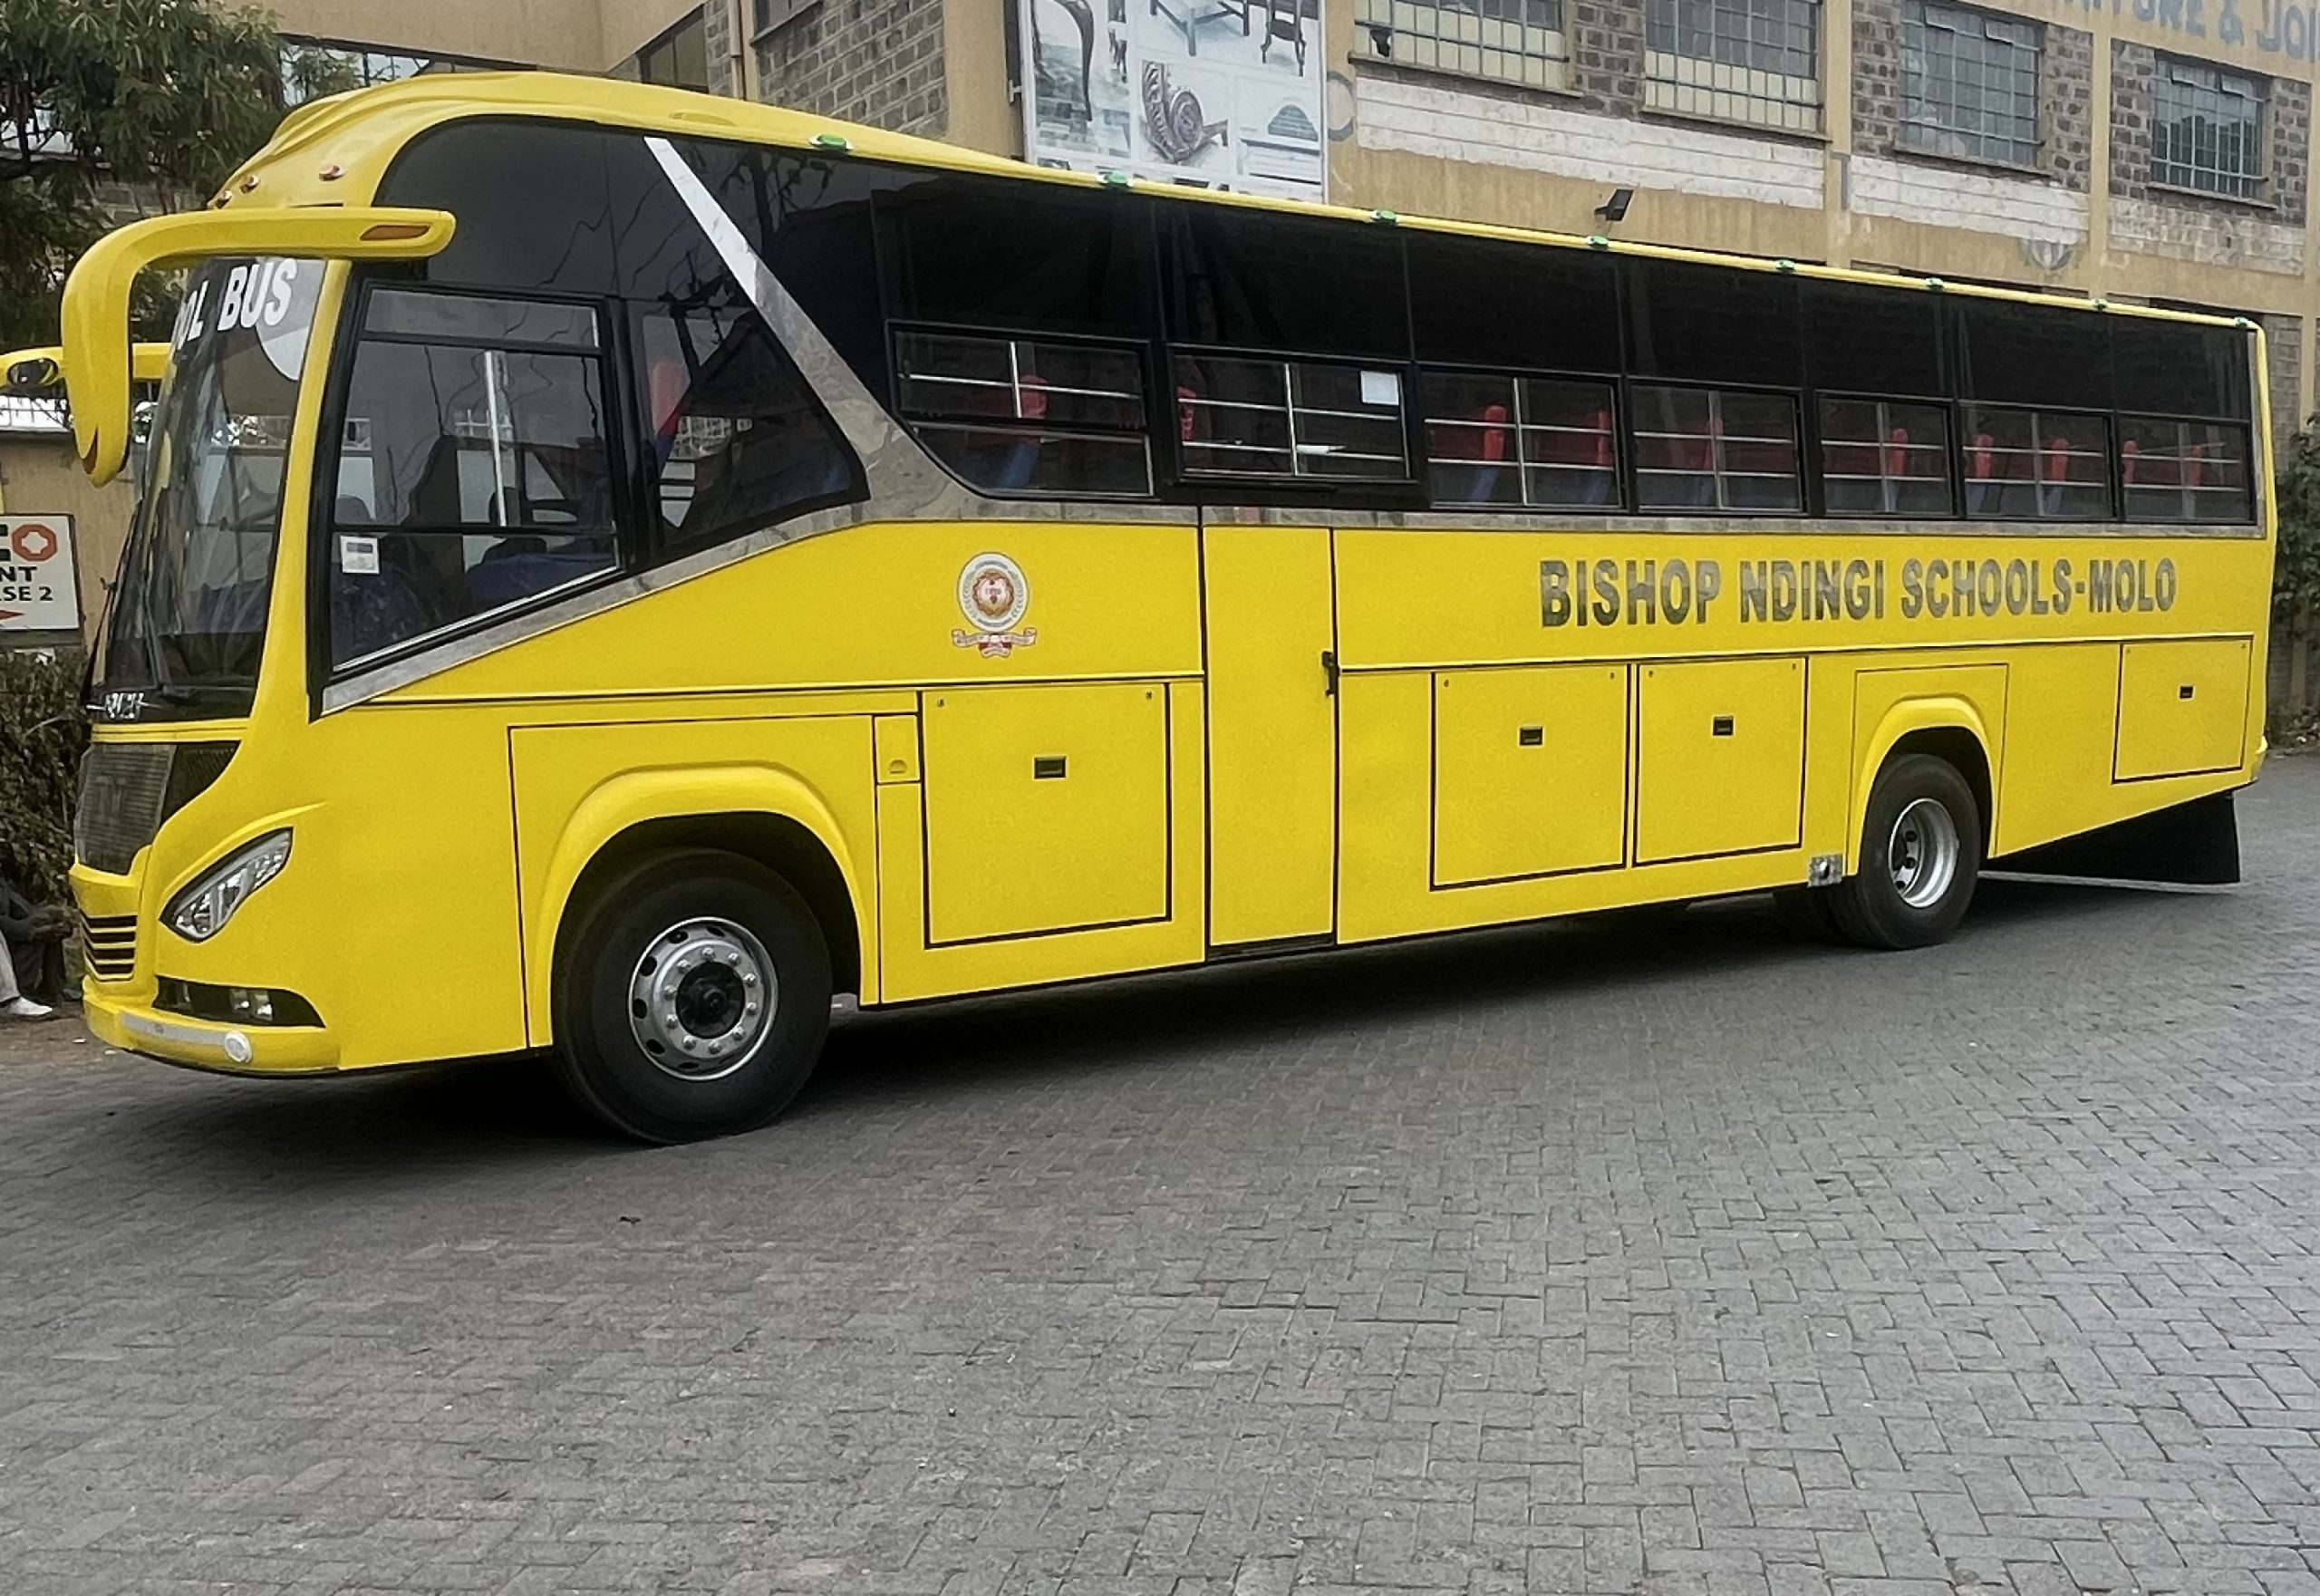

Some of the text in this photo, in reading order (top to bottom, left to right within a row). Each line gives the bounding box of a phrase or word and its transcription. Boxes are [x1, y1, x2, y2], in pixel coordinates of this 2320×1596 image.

[2256, 0, 2320, 63] JOI
[170, 257, 297, 351] OL BUS
[0, 585, 53, 602] SE 2
[1541, 557, 2176, 627] BISHOP NDINGI SCHOOLS-MOLO
